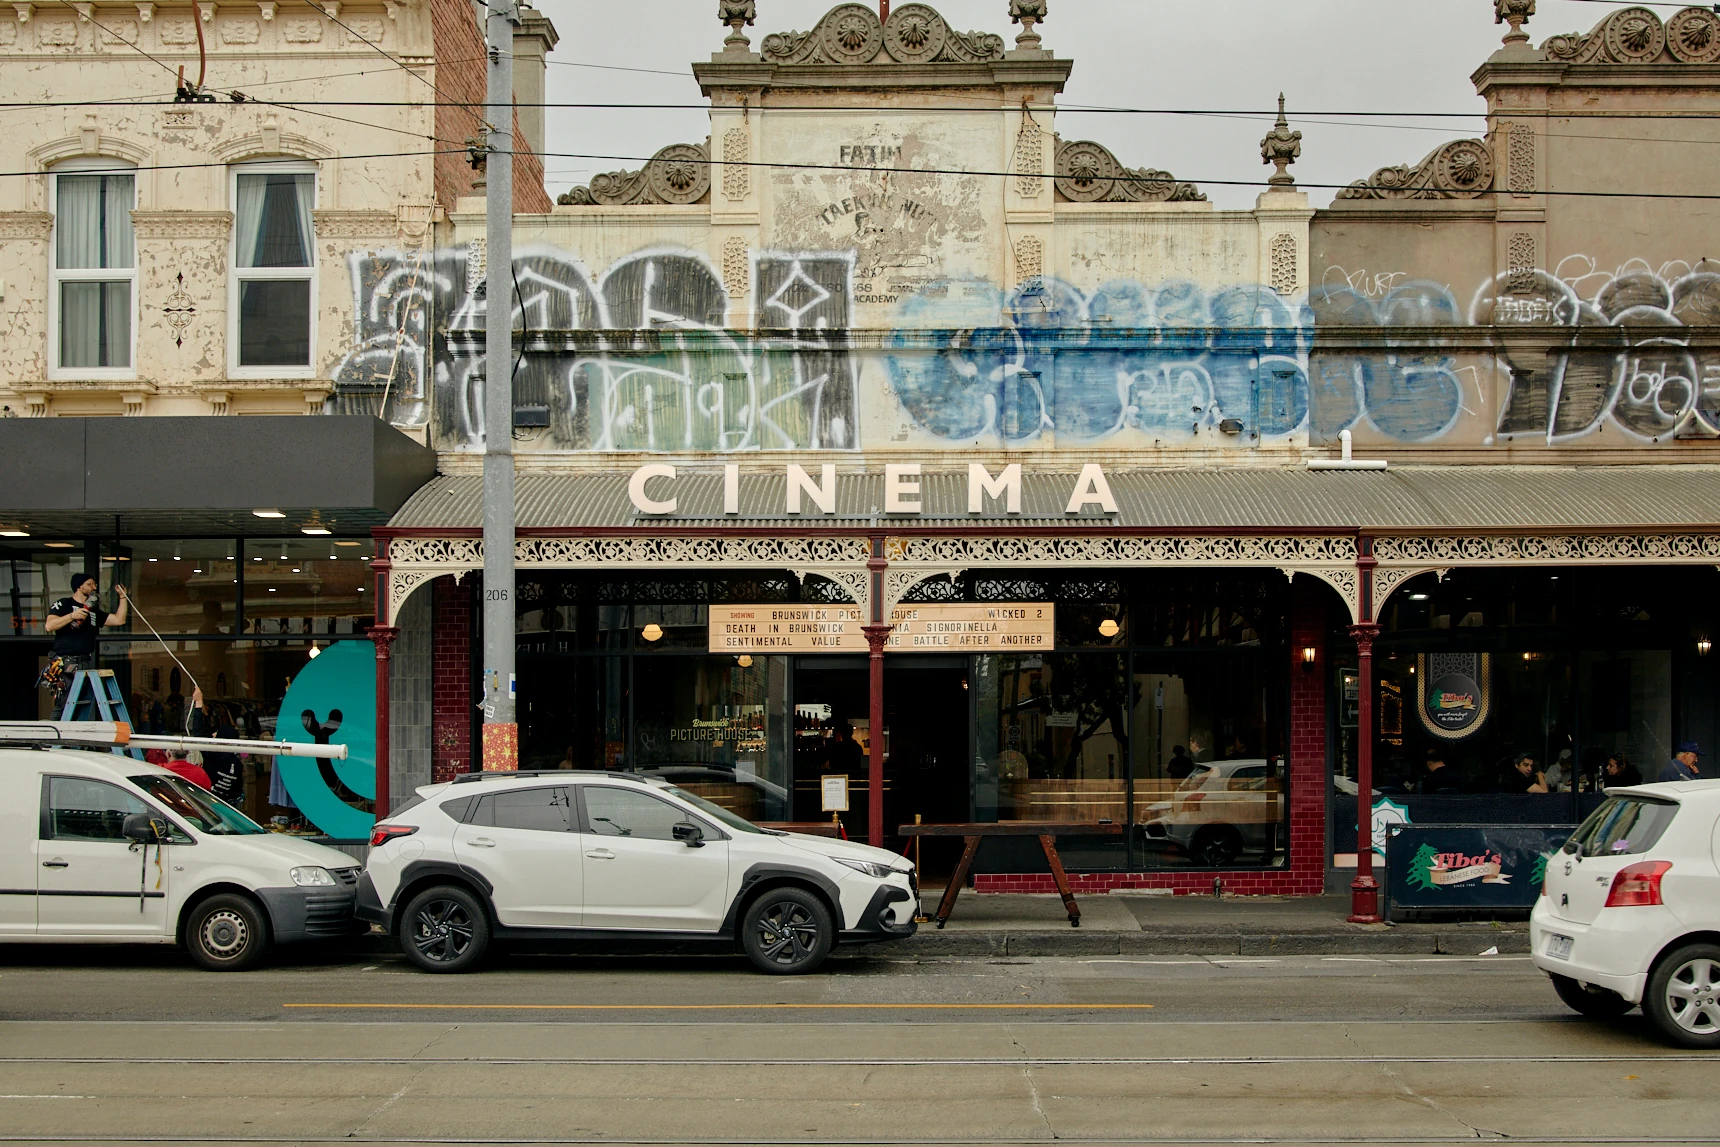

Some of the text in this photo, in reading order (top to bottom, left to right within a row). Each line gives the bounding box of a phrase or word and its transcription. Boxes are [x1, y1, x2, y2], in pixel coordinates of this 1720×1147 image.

[628, 463, 1119, 515] CINEMA
[486, 589, 508, 601] 206
[772, 611, 827, 620] BRUNSWICK
[838, 611, 864, 619] PICT
[988, 610, 1026, 619] WICKED
[1037, 610, 1042, 618] 2
[726, 624, 756, 633] DEATH
[769, 624, 779, 633] IN
[789, 624, 844, 633] BRUNSWICK
[926, 622, 997, 632] SIGNORINELLA
[726, 637, 792, 646] SENTIMENTAL
[811, 637, 841, 646] VALUE
[913, 636, 949, 645] BATTLE
[959, 635, 989, 645] AFTER
[1001, 635, 1042, 645] ANOTHER
[692, 718, 729, 728] Brunswick
[670, 729, 752, 741] PICTURE HOUSE
[1434, 849, 1502, 869] Tiba's
[1440, 866, 1490, 883] LEBANESE FOOD
